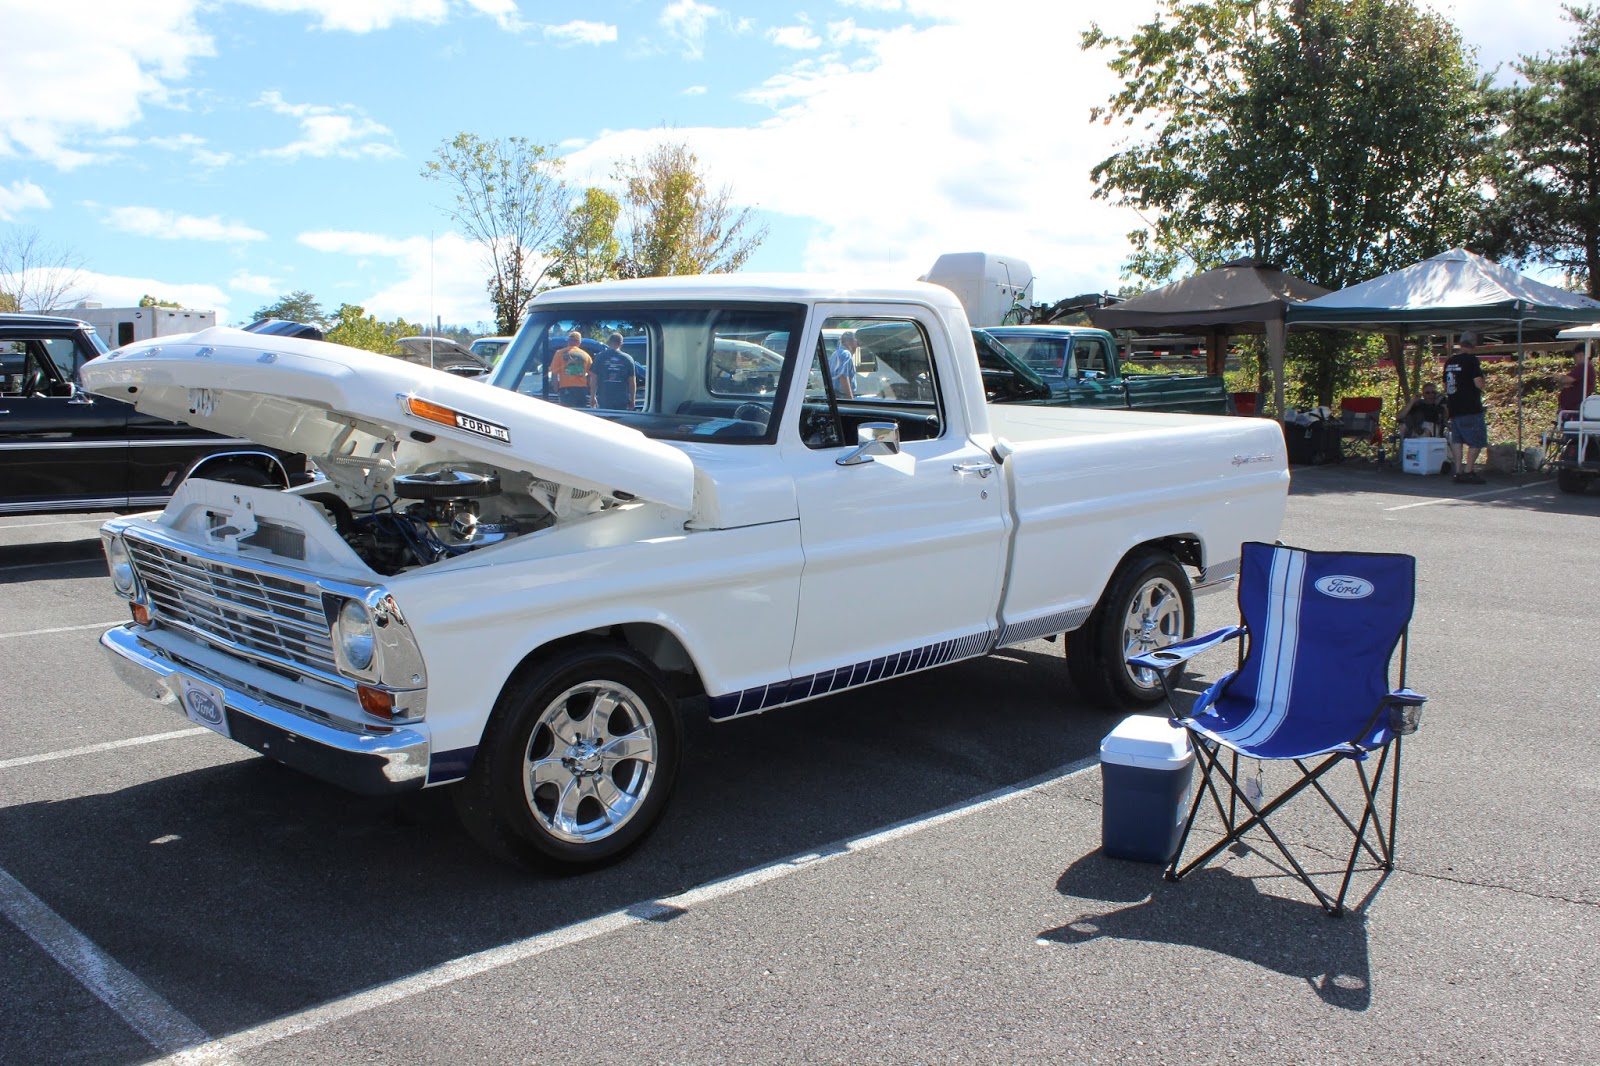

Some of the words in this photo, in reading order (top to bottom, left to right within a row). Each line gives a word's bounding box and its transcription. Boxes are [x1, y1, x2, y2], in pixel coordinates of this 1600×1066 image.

[462, 417, 492, 434] FORD
[1327, 578, 1362, 595] Ford
[193, 693, 217, 719] Ford
